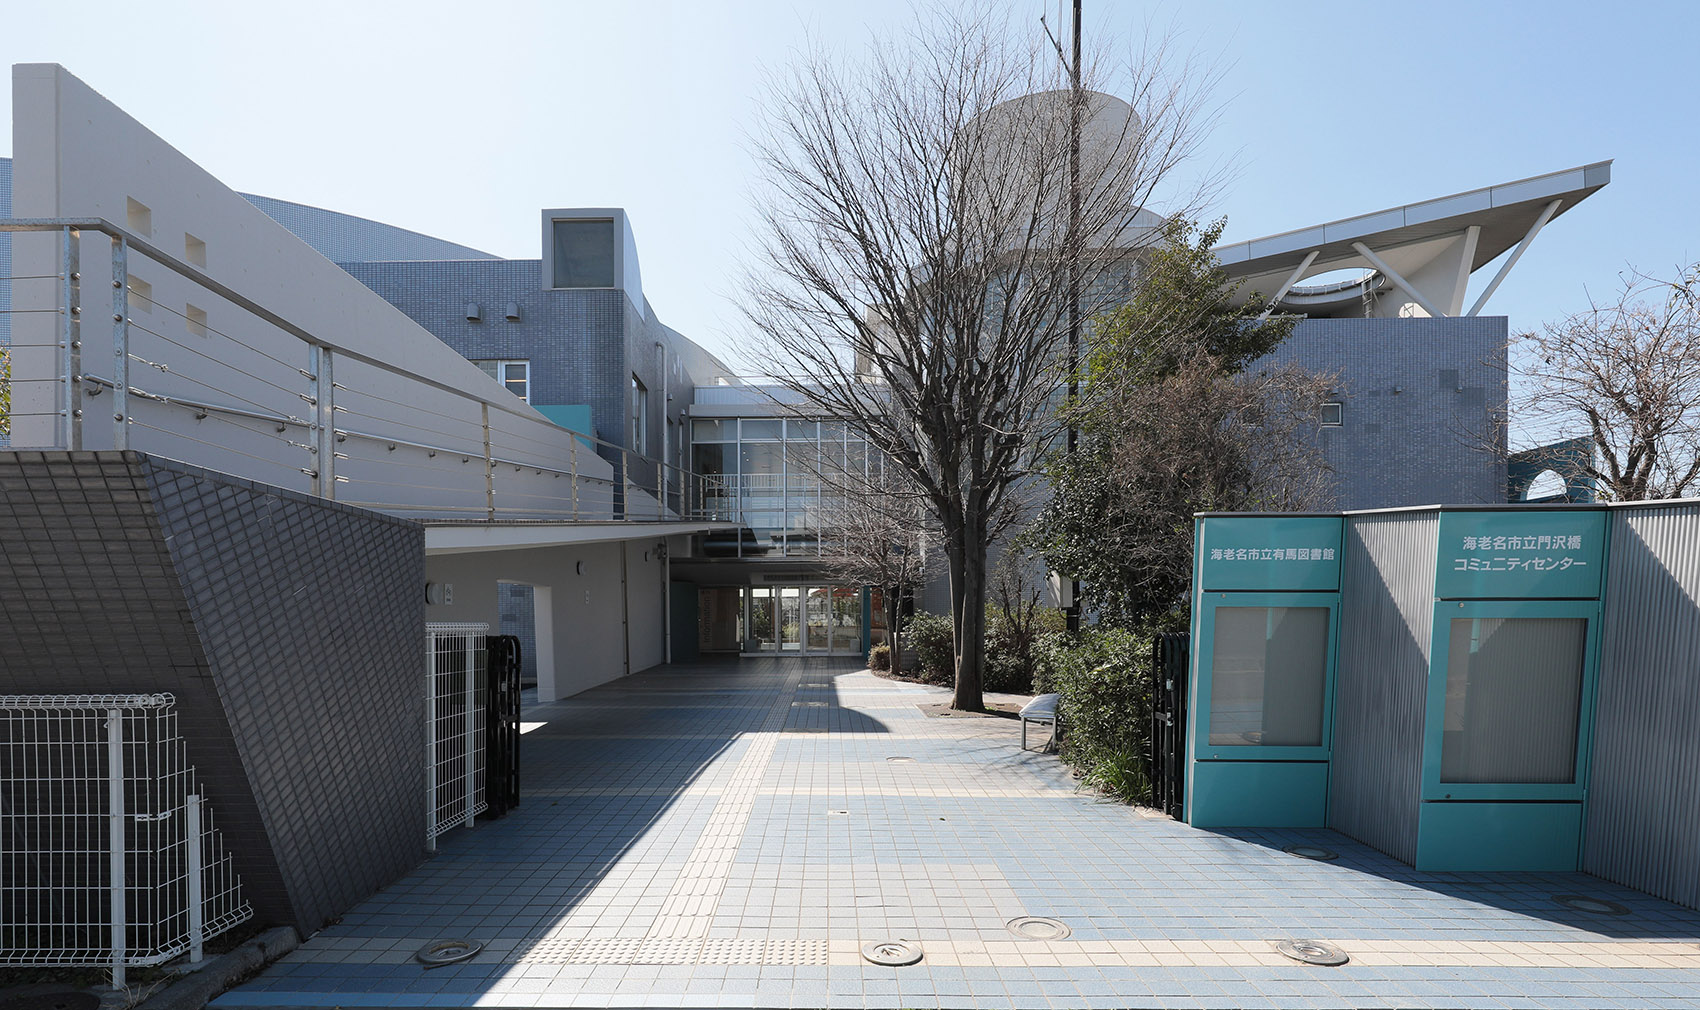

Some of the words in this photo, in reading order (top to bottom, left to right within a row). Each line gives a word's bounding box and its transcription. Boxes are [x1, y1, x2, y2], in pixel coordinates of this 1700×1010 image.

[1462, 535, 1582, 550] 海老名市立門沢橋
[1210, 548, 1335, 561] 海老名市立有馬図書館
[1454, 557, 1587, 571] コミュニティセンター
